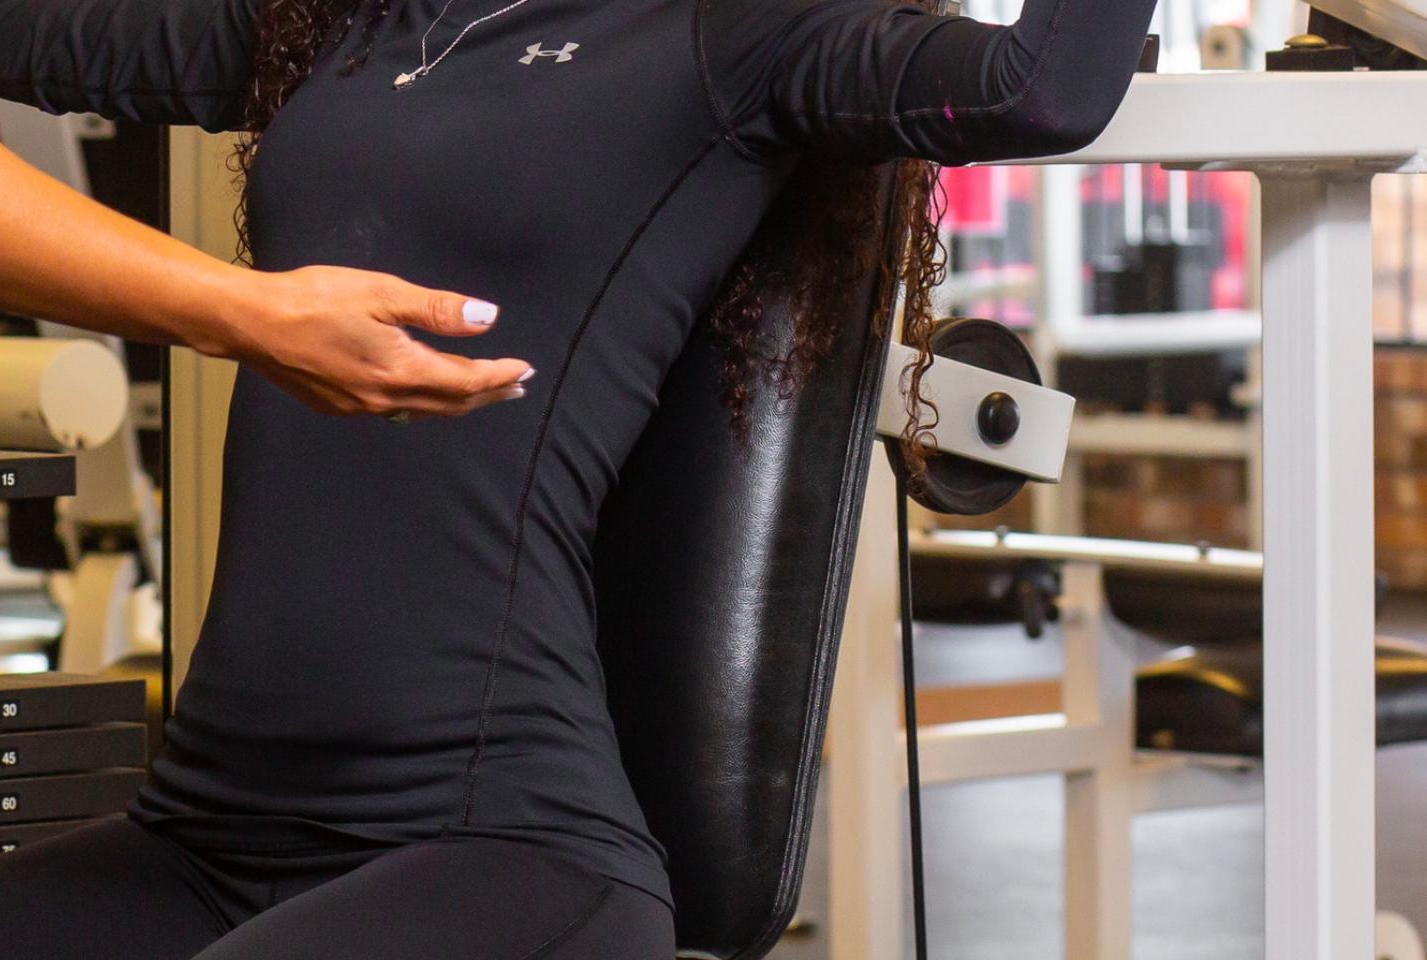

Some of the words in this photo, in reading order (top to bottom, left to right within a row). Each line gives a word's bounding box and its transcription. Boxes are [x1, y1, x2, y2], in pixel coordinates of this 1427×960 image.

[2, 473, 15, 486] 15
[2, 703, 17, 717] 30
[2, 751, 16, 765] 45
[2, 797, 16, 810] 60
